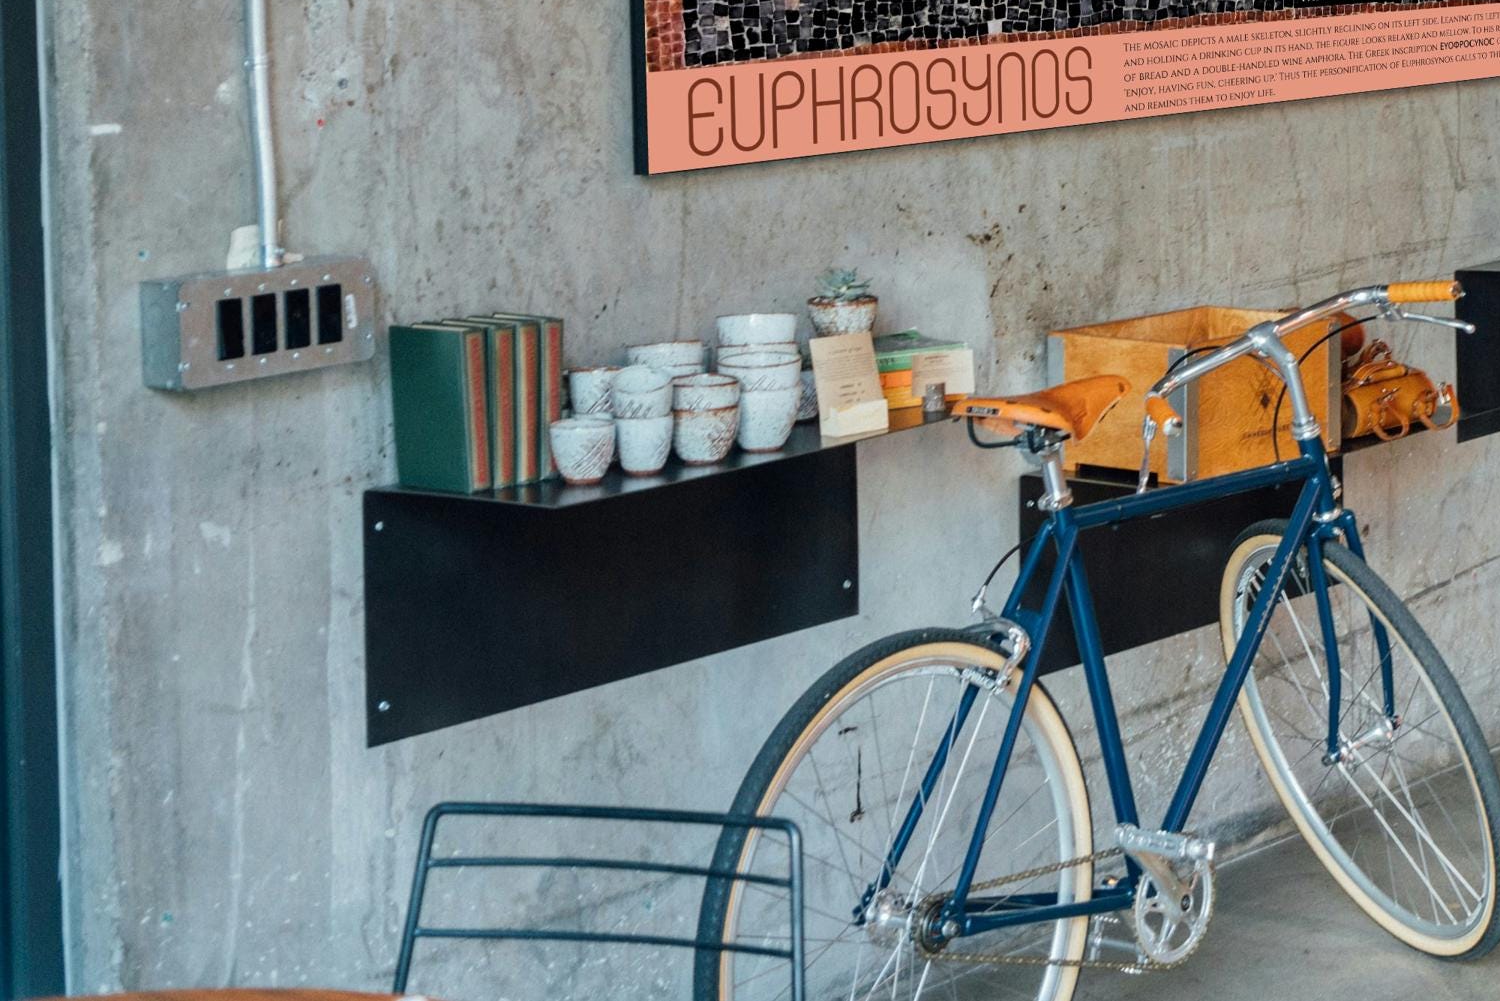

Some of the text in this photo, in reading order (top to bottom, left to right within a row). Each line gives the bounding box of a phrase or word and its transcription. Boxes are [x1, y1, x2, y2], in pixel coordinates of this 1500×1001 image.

[1123, 41, 1141, 52] THE
[1143, 39, 1178, 50] MOSAIC
[1180, 35, 1216, 47] DEPICTS
[1225, 33, 1249, 43] MALE
[1294, 26, 1331, 37] SLIGHTLY
[1333, 22, 1375, 33] RECLINING
[1377, 21, 1390, 30] ON
[1391, 20, 1402, 28] ITS
[1403, 18, 1420, 27] LEFT
[1440, 13, 1472, 24] LEANING
[1473, 13, 1483, 21] ITS
[1484, 12, 1499, 20] LEFT
[1123, 57, 1144, 67] AND
[1146, 53, 1188, 65] HOLDING
[1198, 48, 1242, 60] DRINKING
[1243, 46, 1261, 55] CUP
[1262, 45, 1272, 54] IN
[1274, 44, 1286, 53] ITS
[1316, 40, 1330, 49] THE
[1332, 37, 1359, 47] FIGURE
[1361, 35, 1386, 44] LOOKS
[1387, 32, 1420, 42] RELAXED
[1421, 30, 1438, 39] AND
[1472, 25, 1482, 34] TO
[1483, 25, 1494, 33] HIS
[1123, 73, 1136, 82] OF
[1138, 70, 1168, 80] BREAD
[1170, 67, 1191, 77] AND
[1201, 59, 1279, 74] DOUBLE-HANDLED
[1281, 56, 1302, 66] WINE
[1348, 50, 1363, 60] THE
[1364, 48, 1389, 58] GREEK
[1391, 43, 1438, 55] INSCRIPTION
[1157, 81, 1194, 94] HAVING
[1217, 74, 1261, 87] CHEERING
[1278, 70, 1300, 81] THUS
[1301, 69, 1317, 78] THE
[1319, 61, 1387, 76] PERSONIFICATION
[1389, 60, 1399, 69] OF
[1401, 54, 1453, 68] EUPHROSYNOS
[1454, 52, 1476, 62] CALLS
[1477, 50, 1487, 60] TO
[687, 45, 1093, 157] EUPHROSYNOS
[1124, 102, 1145, 112] AND
[1146, 97, 1187, 110] REMINDS
[1189, 95, 1213, 105] THEM
[1215, 93, 1227, 102] TO
[1229, 90, 1255, 101] ENJOY
